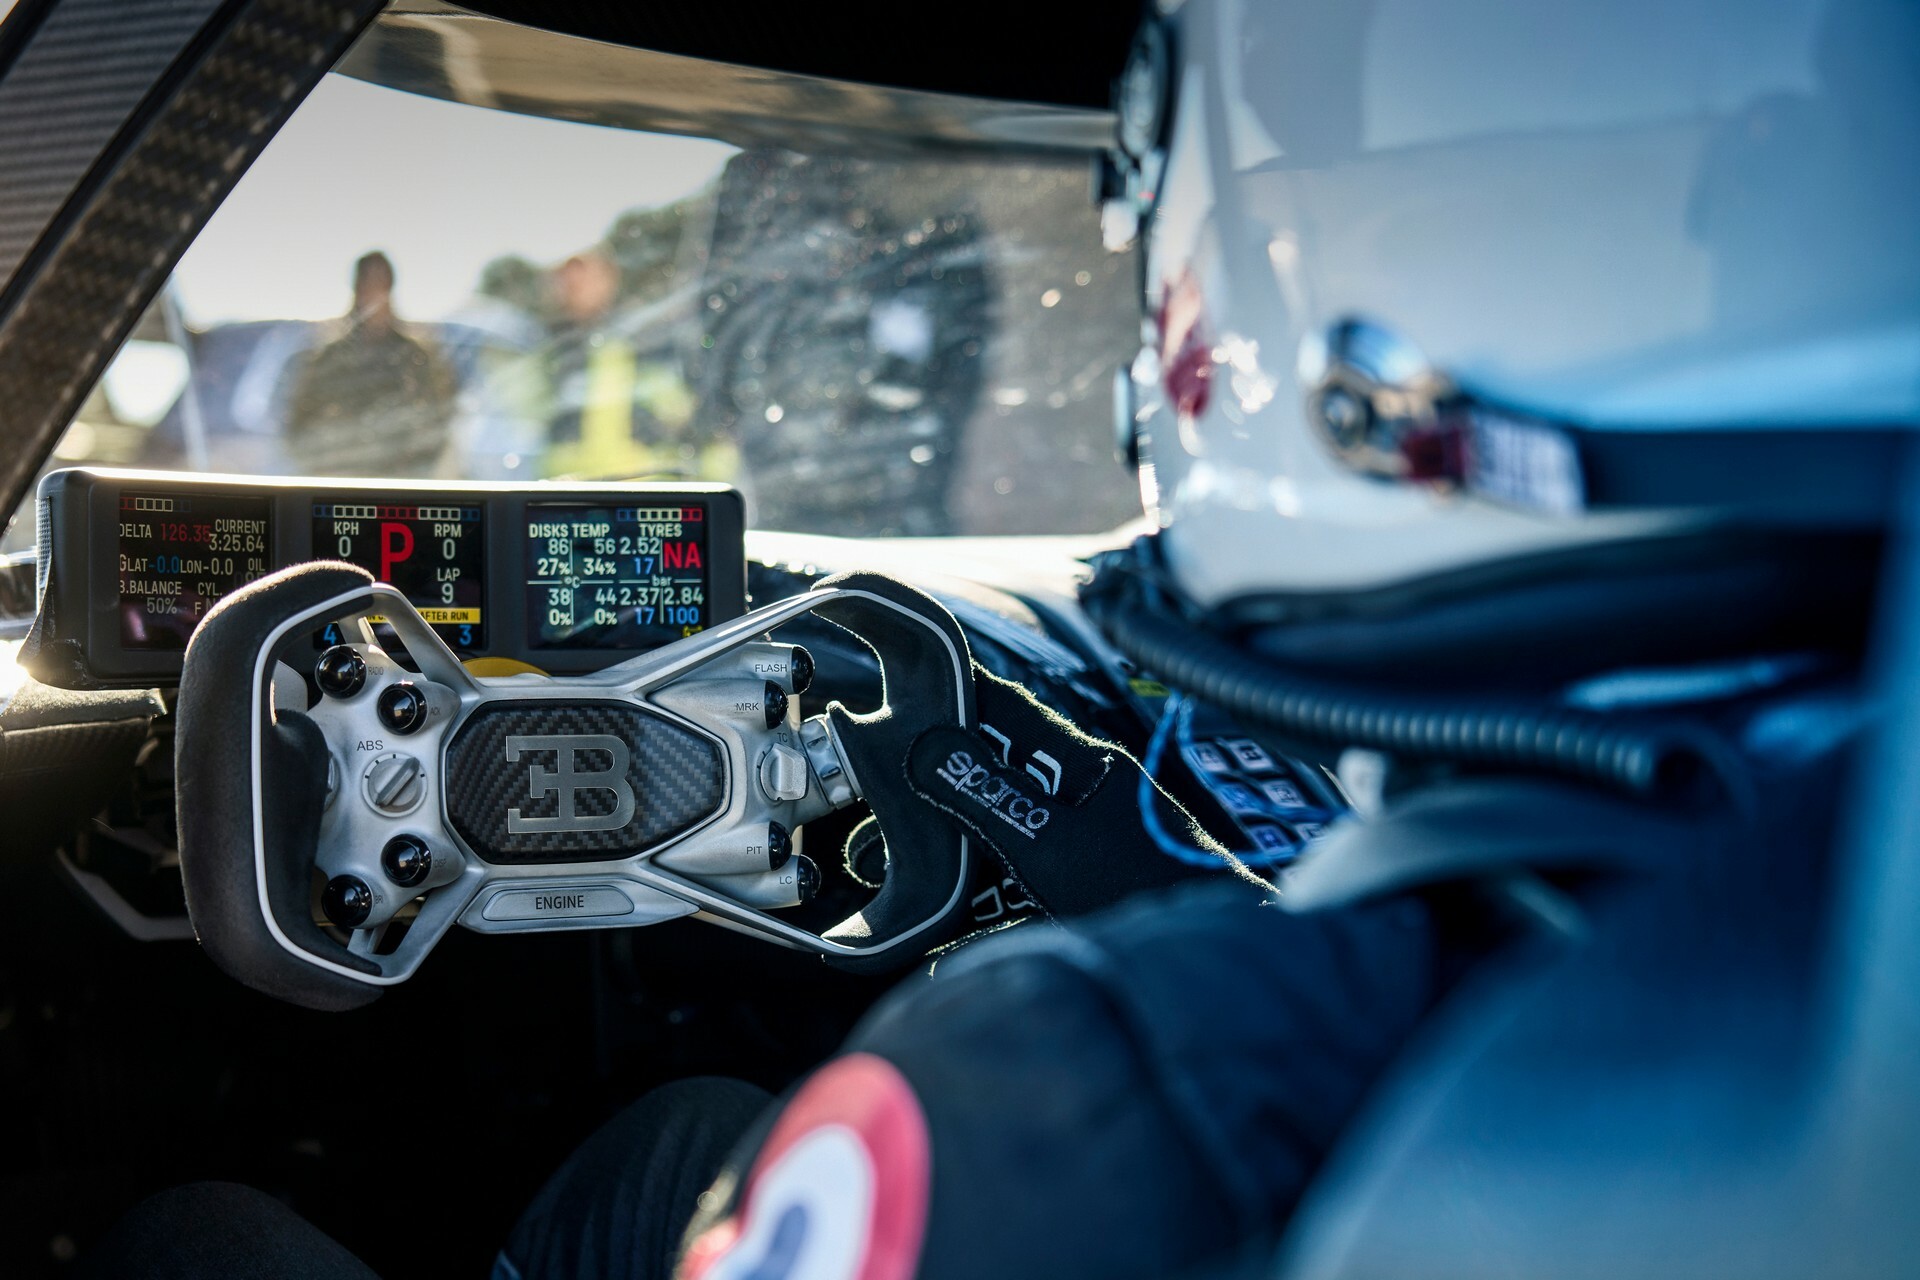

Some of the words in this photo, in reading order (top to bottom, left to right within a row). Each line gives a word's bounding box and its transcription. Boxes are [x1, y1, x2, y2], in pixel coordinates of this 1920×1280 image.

[119, 523, 152, 538] DELTA
[160, 523, 212, 543] 126.35
[215, 519, 266, 534] CURRENT
[334, 521, 359, 535] KPH
[434, 524, 462, 538] RPM
[529, 523, 569, 538] DISKS
[572, 523, 610, 538] TEMP
[639, 523, 682, 537] TYRES
[209, 533, 264, 552] 3:25.64
[338, 536, 351, 557] 0
[443, 538, 455, 560] 0
[548, 538, 569, 555] 86
[594, 538, 615, 555] 56
[381, 522, 415, 582] P
[619, 537, 660, 555] 2.52
[664, 542, 701, 569] NA
[247, 557, 266, 572] OIL
[537, 558, 570, 575] 27%
[583, 558, 616, 575] 34%
[634, 557, 655, 575] 17
[437, 567, 460, 582] LAP
[652, 574, 672, 587] bar
[198, 582, 223, 597] CYL.
[441, 583, 453, 604] 9
[548, 588, 571, 606] 38
[595, 588, 617, 605] 44
[619, 587, 660, 606] 2.37
[664, 587, 704, 605] 2.84
[147, 597, 177, 615] 50%
[450, 611, 469, 621] RUN
[549, 608, 572, 625] 0%
[594, 608, 618, 625] 0%
[634, 607, 655, 625] 17
[666, 606, 699, 625] 100
[323, 624, 337, 645] 4
[459, 624, 472, 646] 3
[755, 664, 788, 673] FLASH
[736, 702, 759, 711] MRK
[356, 740, 384, 751] ABS
[777, 732, 788, 743] TC
[946, 750, 1050, 830] sparco
[746, 846, 762, 855] PIT
[780, 876, 793, 885] LC
[535, 895, 584, 910] ENGINE
